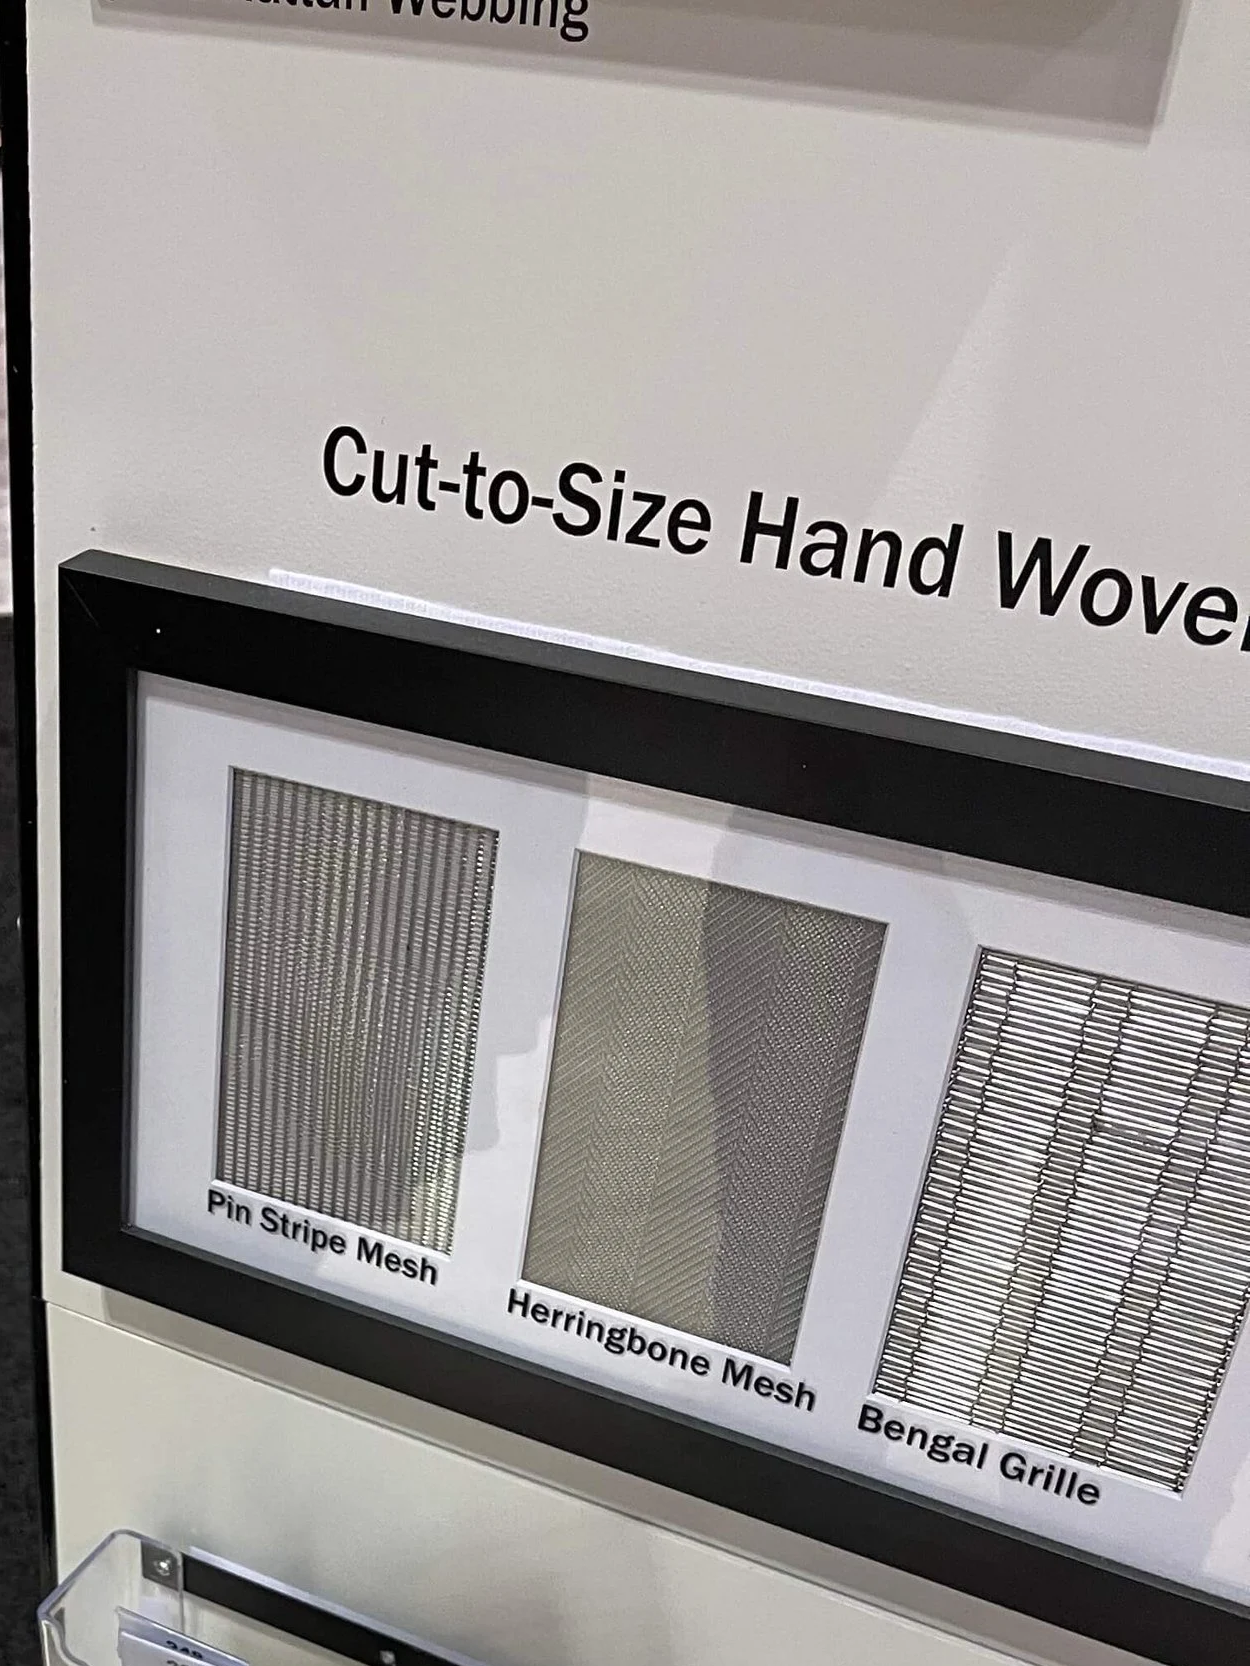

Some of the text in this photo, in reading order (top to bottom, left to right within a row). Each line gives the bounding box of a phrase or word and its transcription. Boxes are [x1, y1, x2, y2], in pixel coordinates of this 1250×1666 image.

[322, 425, 1250, 652] Cut-to-Size Hand Wove
[207, 1188, 438, 1286] Pin Stripe Mesh
[506, 1287, 817, 1412] Herringbone Mesh
[857, 1403, 1101, 1506] Bengal Grille
